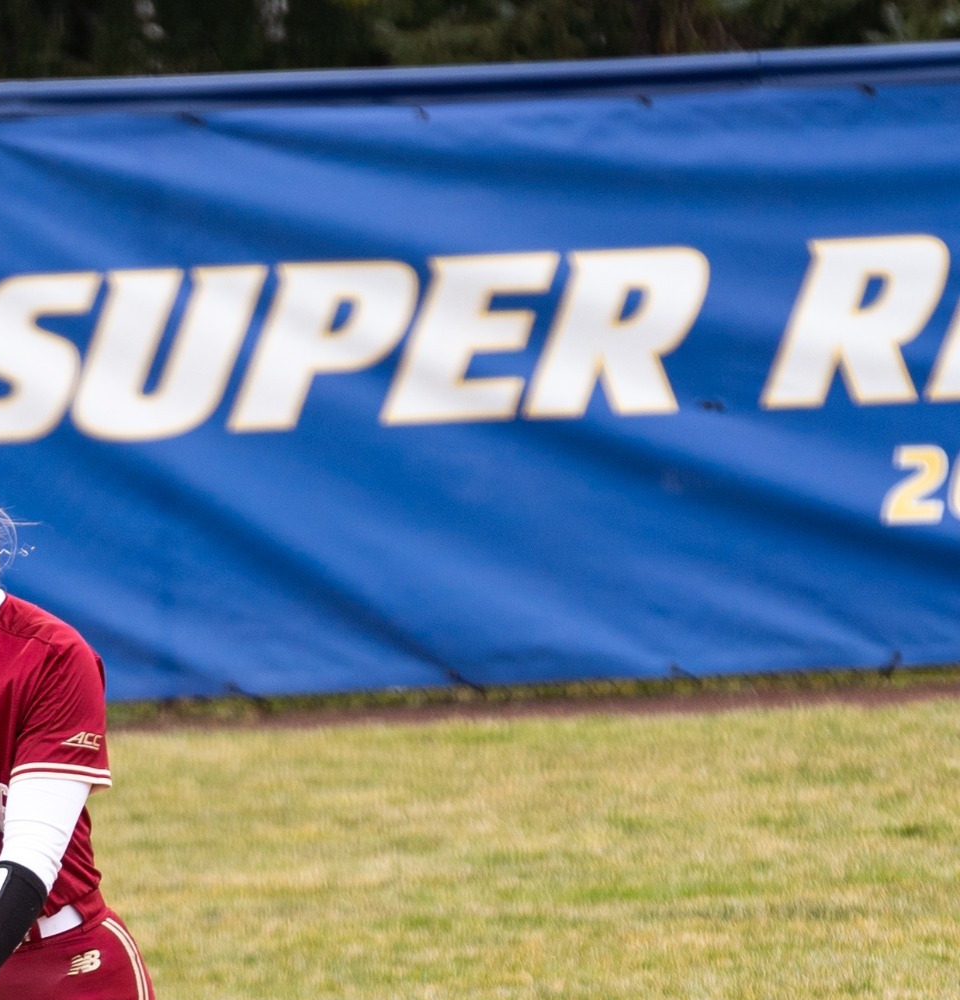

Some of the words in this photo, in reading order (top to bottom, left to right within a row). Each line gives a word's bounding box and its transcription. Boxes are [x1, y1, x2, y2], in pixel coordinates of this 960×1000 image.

[759, 233, 960, 411] R
[879, 444, 960, 528] 2
[61, 731, 103, 750] ACC
